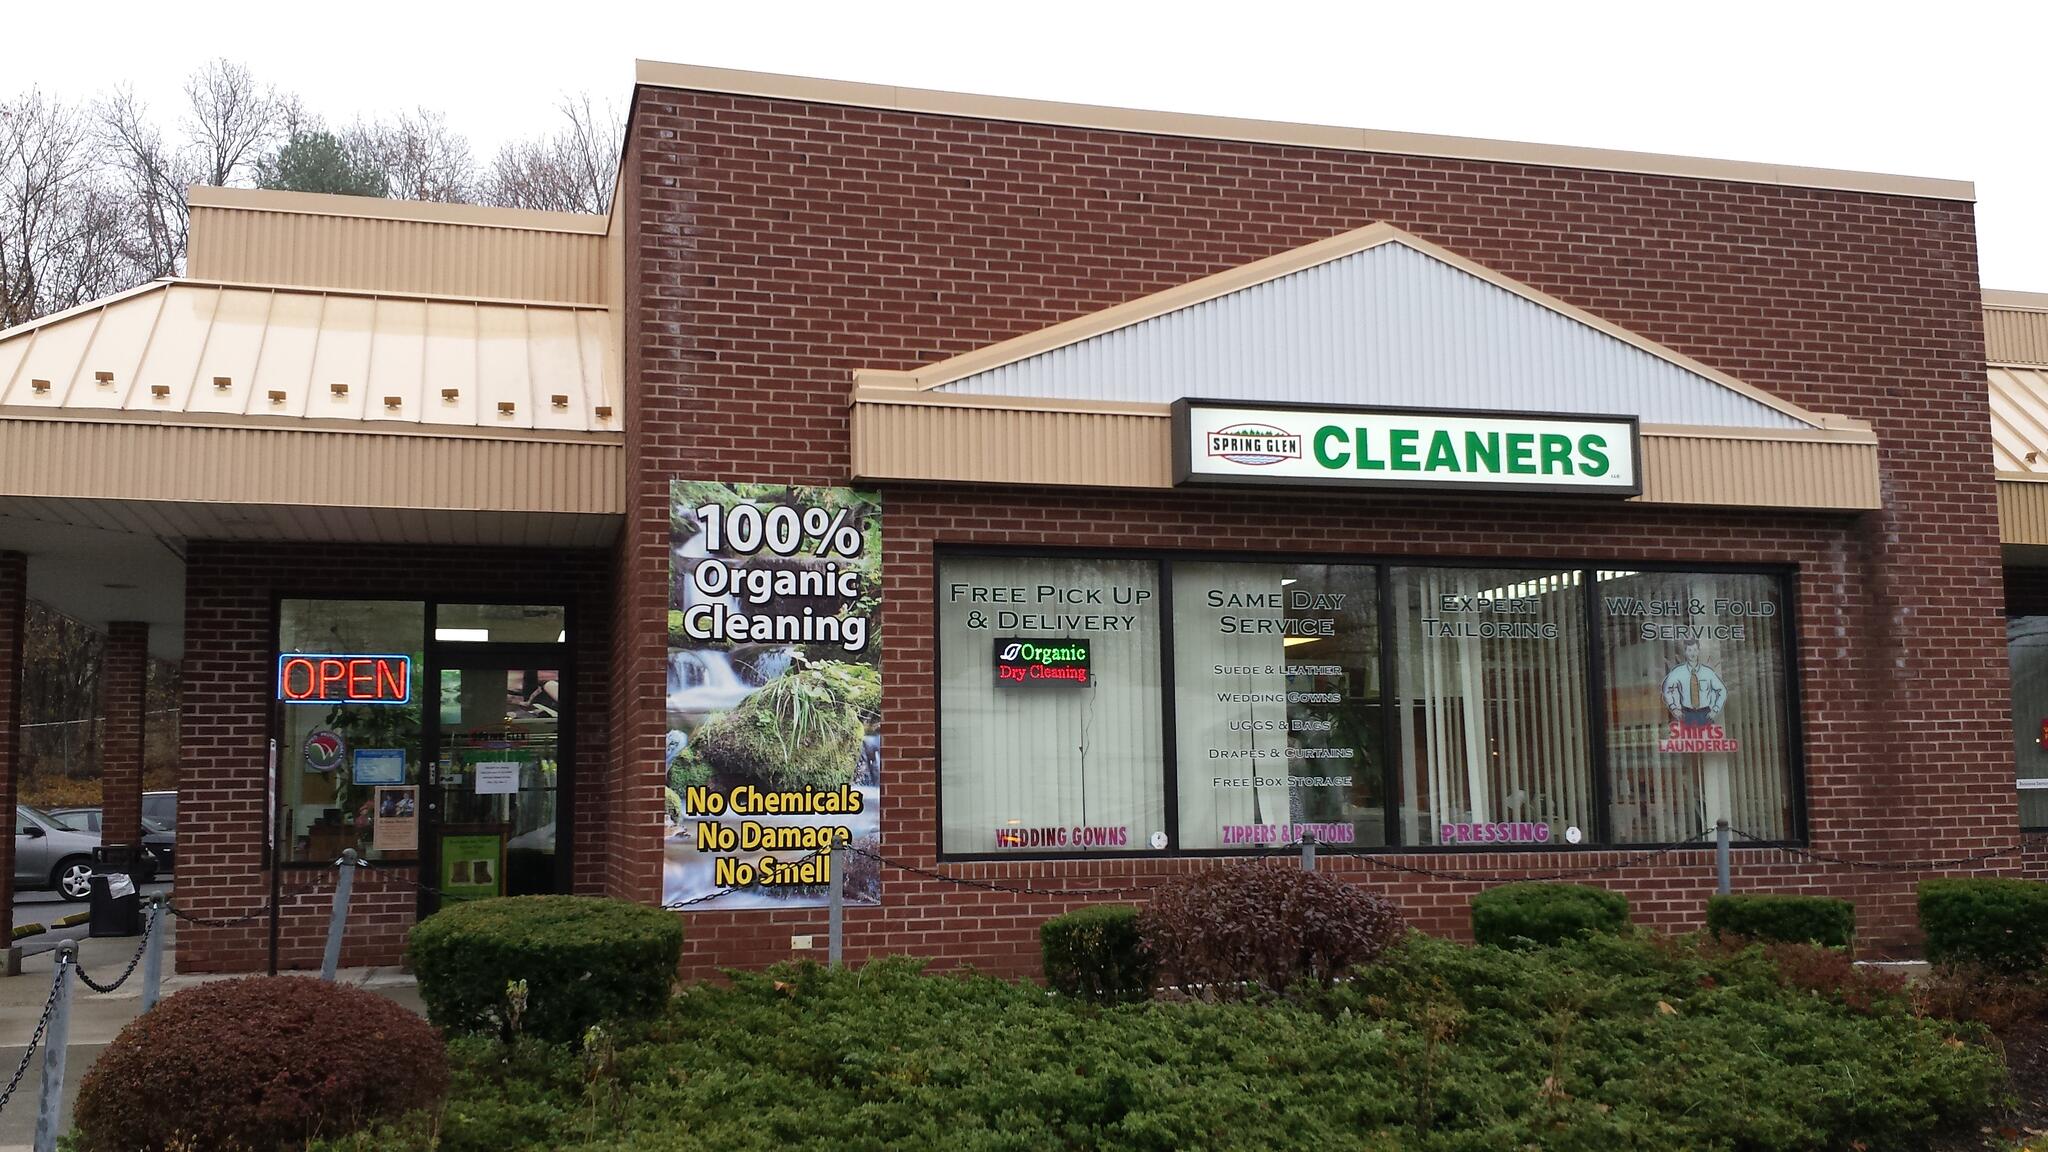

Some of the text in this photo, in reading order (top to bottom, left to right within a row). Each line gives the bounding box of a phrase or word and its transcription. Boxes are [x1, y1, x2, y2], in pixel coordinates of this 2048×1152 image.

[1213, 437, 1296, 453] SPRING GLEN
[1313, 425, 1611, 478] CLEANERS
[696, 503, 863, 559] 100%
[694, 559, 861, 604] Organic
[950, 583, 1152, 605] FREE PICK UP
[1207, 590, 1346, 610] SAME DAY
[1439, 593, 1541, 615] EXPERT
[1604, 596, 1776, 618] WASH & FOLD
[683, 604, 868, 651] Cleaning
[966, 610, 1137, 631] & DELIVERY
[1220, 615, 1335, 636] SERVICE
[1422, 618, 1559, 640] TAILORING
[1640, 621, 1746, 641] SERVICE
[1021, 643, 1086, 665] Organic
[283, 659, 406, 700] OPEN
[1000, 665, 1088, 682] Dry Cleaning
[1214, 664, 1342, 676] SUEDE & LEATHER
[1217, 692, 1341, 704] WEDDING GOWNS
[1229, 720, 1331, 732] UGGS & BAGS
[1669, 720, 1724, 739] Shirts
[1209, 747, 1354, 760] DRAPES & CURTAINS
[1658, 740, 1738, 752] LAUNDERED
[1213, 776, 1353, 788] FREE BOX STORAGE
[686, 784, 864, 815] No Chemicals
[698, 821, 737, 852] No
[996, 826, 1128, 848] WEDDING GOWNS
[1222, 823, 1355, 844] ZIPPERS & BTTONS
[1440, 823, 1549, 843] PRESSING
[715, 855, 832, 887] No Smell
